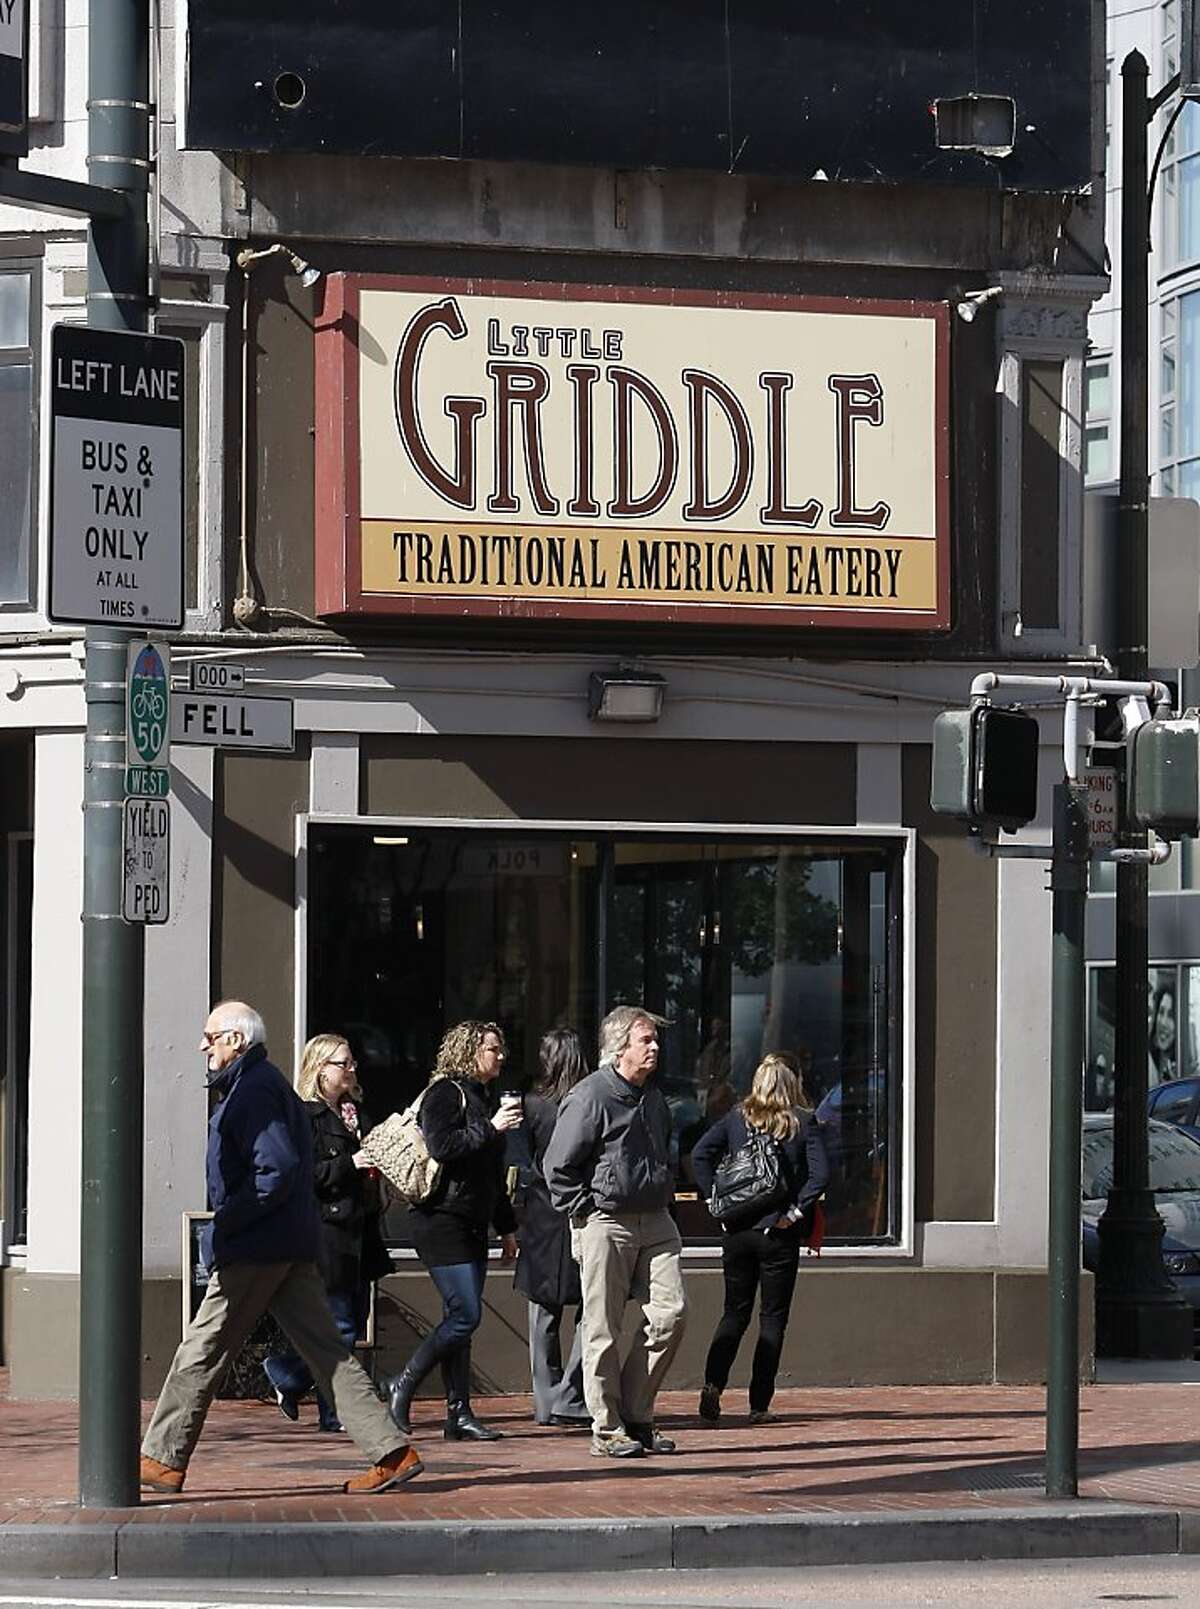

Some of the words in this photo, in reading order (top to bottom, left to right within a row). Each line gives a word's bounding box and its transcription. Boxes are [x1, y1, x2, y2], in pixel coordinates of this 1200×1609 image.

[487, 319, 623, 360] LITTLE
[57, 358, 113, 393] LEFT
[120, 364, 180, 401] LANE
[394, 297, 890, 529] GRIDDLE
[82, 440, 128, 473] BUS
[137, 446, 154, 476] &
[92, 484, 141, 518] TAXI
[85, 526, 149, 560] ONLY
[96, 571, 112, 586] AT
[115, 572, 139, 589] ALL
[393, 532, 606, 588] TRADITIONAL
[617, 540, 775, 594] AMERICAN
[786, 545, 903, 598] EATERY
[100, 600, 135, 617] TIMES
[138, 722, 162, 752] 50
[183, 703, 254, 737] FELL
[131, 769, 165, 794] WEST
[129, 807, 167, 838] YIELD
[142, 851, 154, 870] TO
[134, 884, 160, 914] PED
